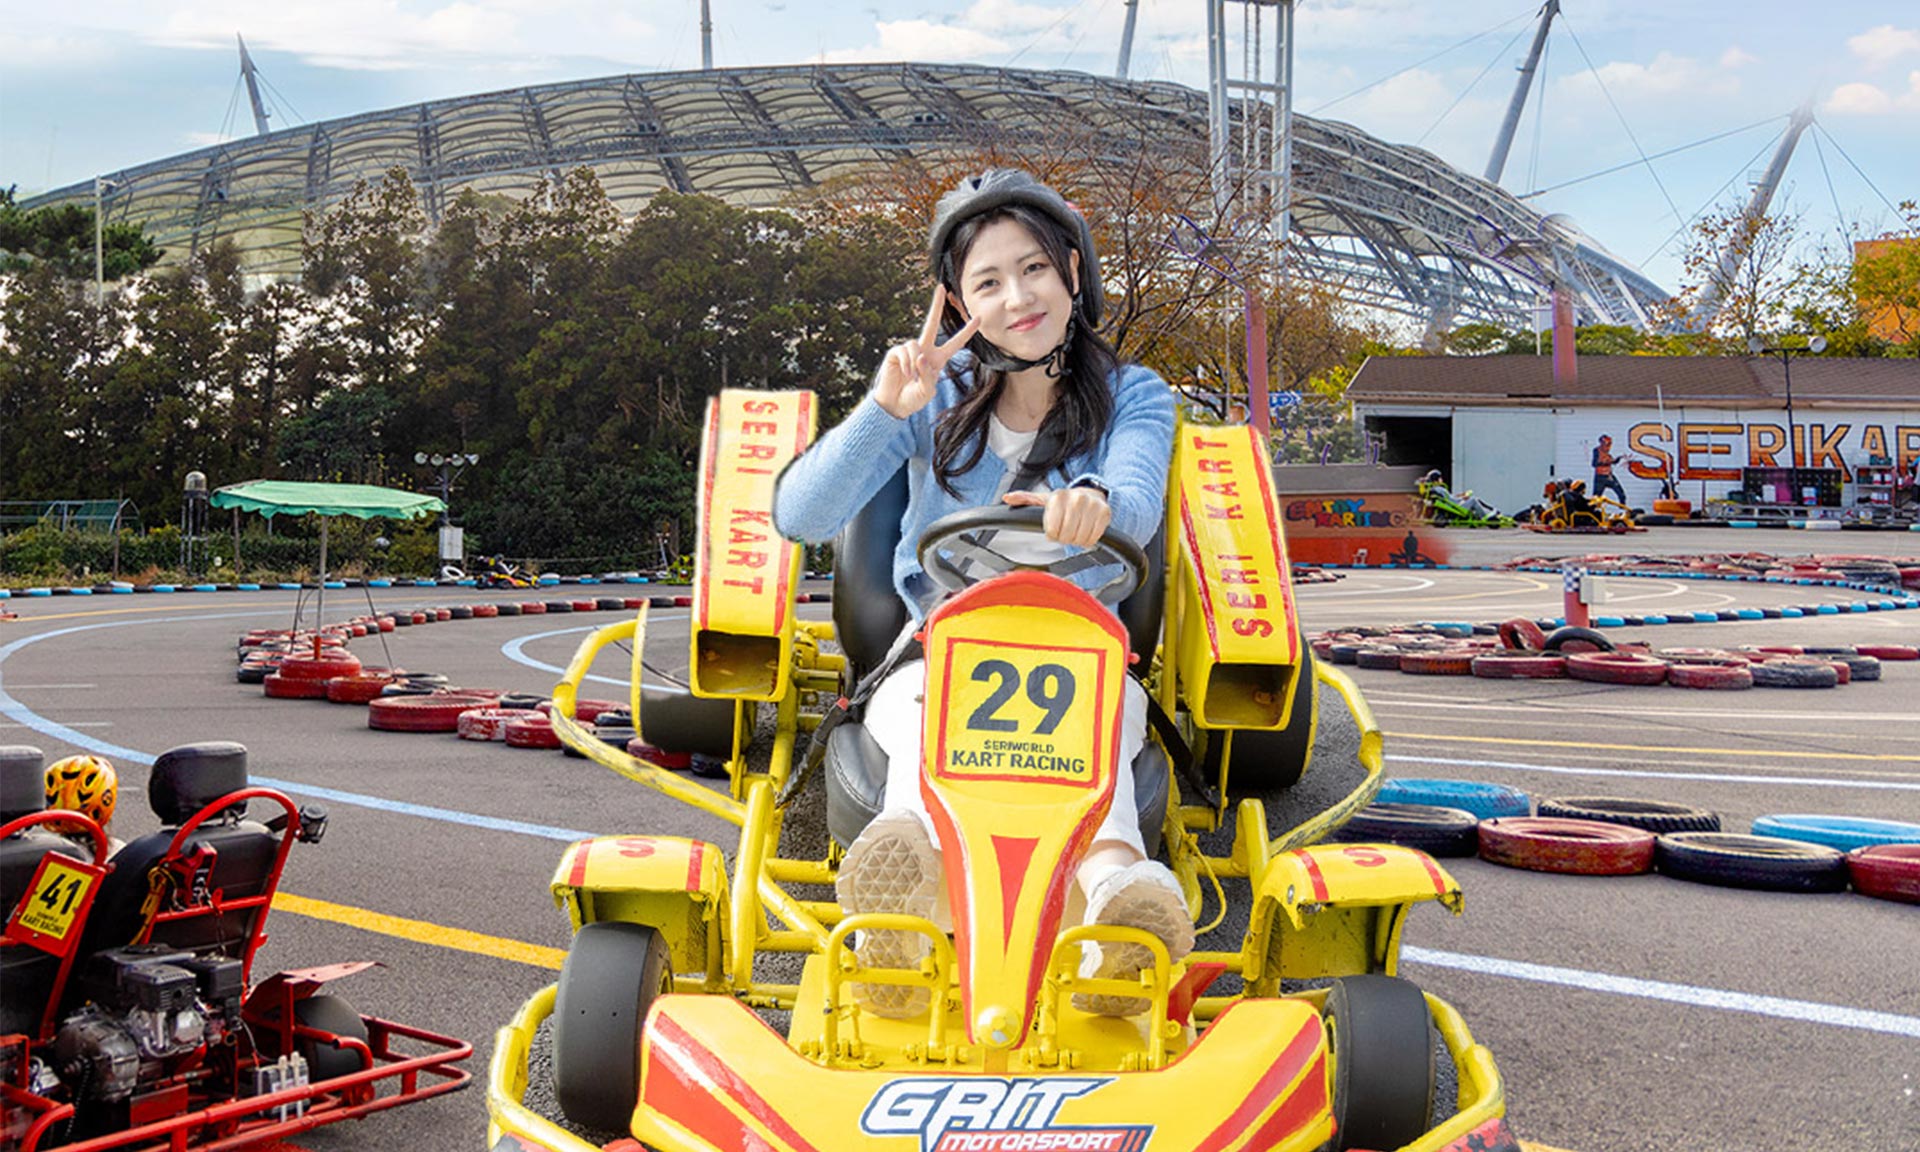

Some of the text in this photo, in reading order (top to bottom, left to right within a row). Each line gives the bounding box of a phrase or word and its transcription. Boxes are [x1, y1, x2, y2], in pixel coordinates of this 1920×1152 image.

[723, 401, 780, 595] SERI KART
[1193, 436, 1274, 638] SERI KART
[966, 659, 1076, 735] 29
[951, 750, 1085, 774] KART RACING
[983, 739, 1055, 754] SERIWORLD
[616, 837, 657, 858] S
[1343, 846, 1387, 867] S
[39, 873, 82, 916] 41
[860, 1076, 1119, 1138] GRIT
[940, 1132, 1124, 1151] MOTORSPORT
